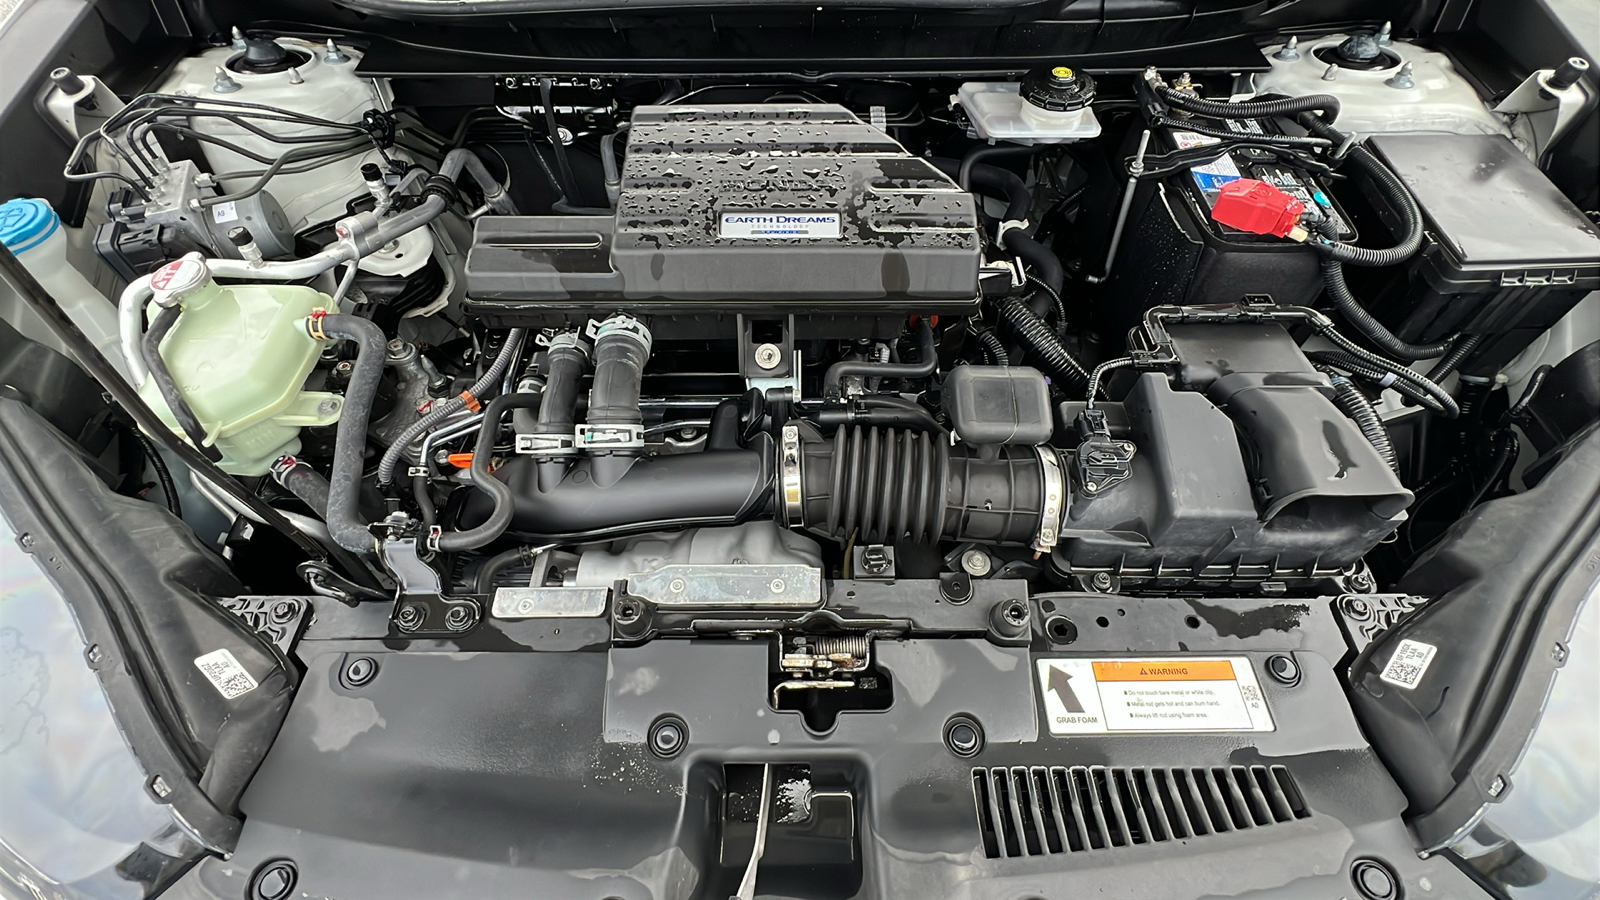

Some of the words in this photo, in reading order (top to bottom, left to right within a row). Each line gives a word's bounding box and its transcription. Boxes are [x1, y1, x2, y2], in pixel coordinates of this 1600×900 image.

[725, 216, 773, 224] EARTH
[776, 215, 836, 224] DREAMS
[1148, 667, 1188, 676] WARNING
[1056, 716, 1076, 724] GRAB
[1077, 716, 1098, 724] FOAM
